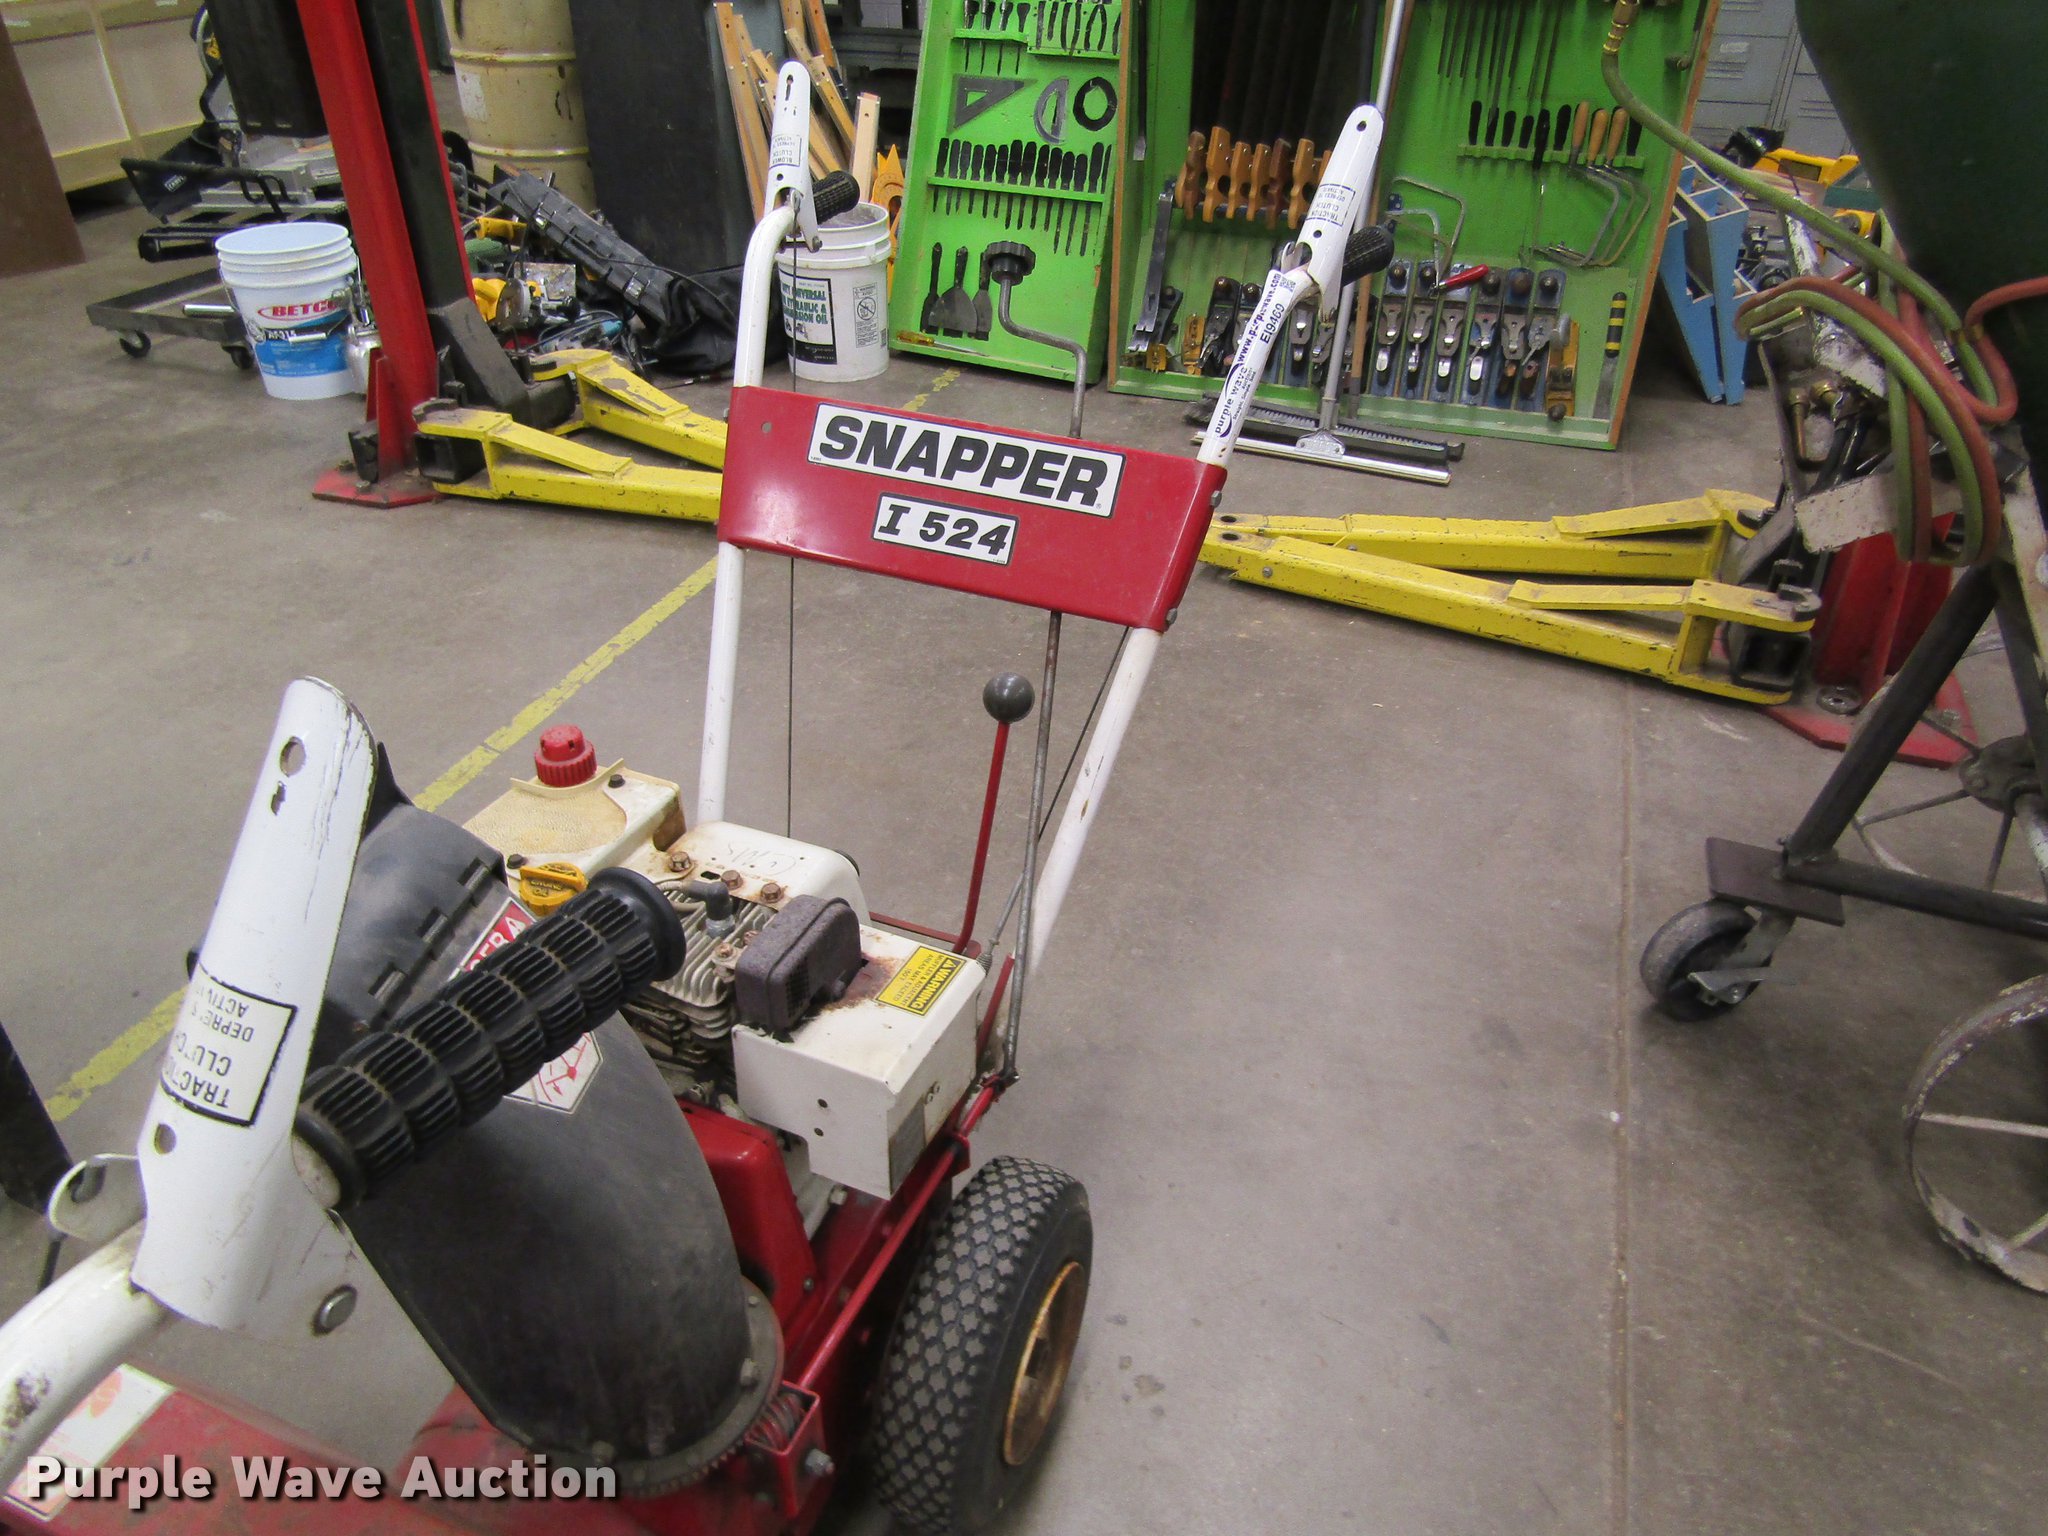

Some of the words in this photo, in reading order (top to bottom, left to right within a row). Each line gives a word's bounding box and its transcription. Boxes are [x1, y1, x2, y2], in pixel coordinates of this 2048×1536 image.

[1311, 210, 1339, 221] TRACTION
[1215, 397, 1235, 435] purple
[819, 415, 1108, 507] SNAPPER
[878, 503, 911, 536] I
[919, 511, 1011, 556] 524
[909, 966, 952, 1010] WARNING
